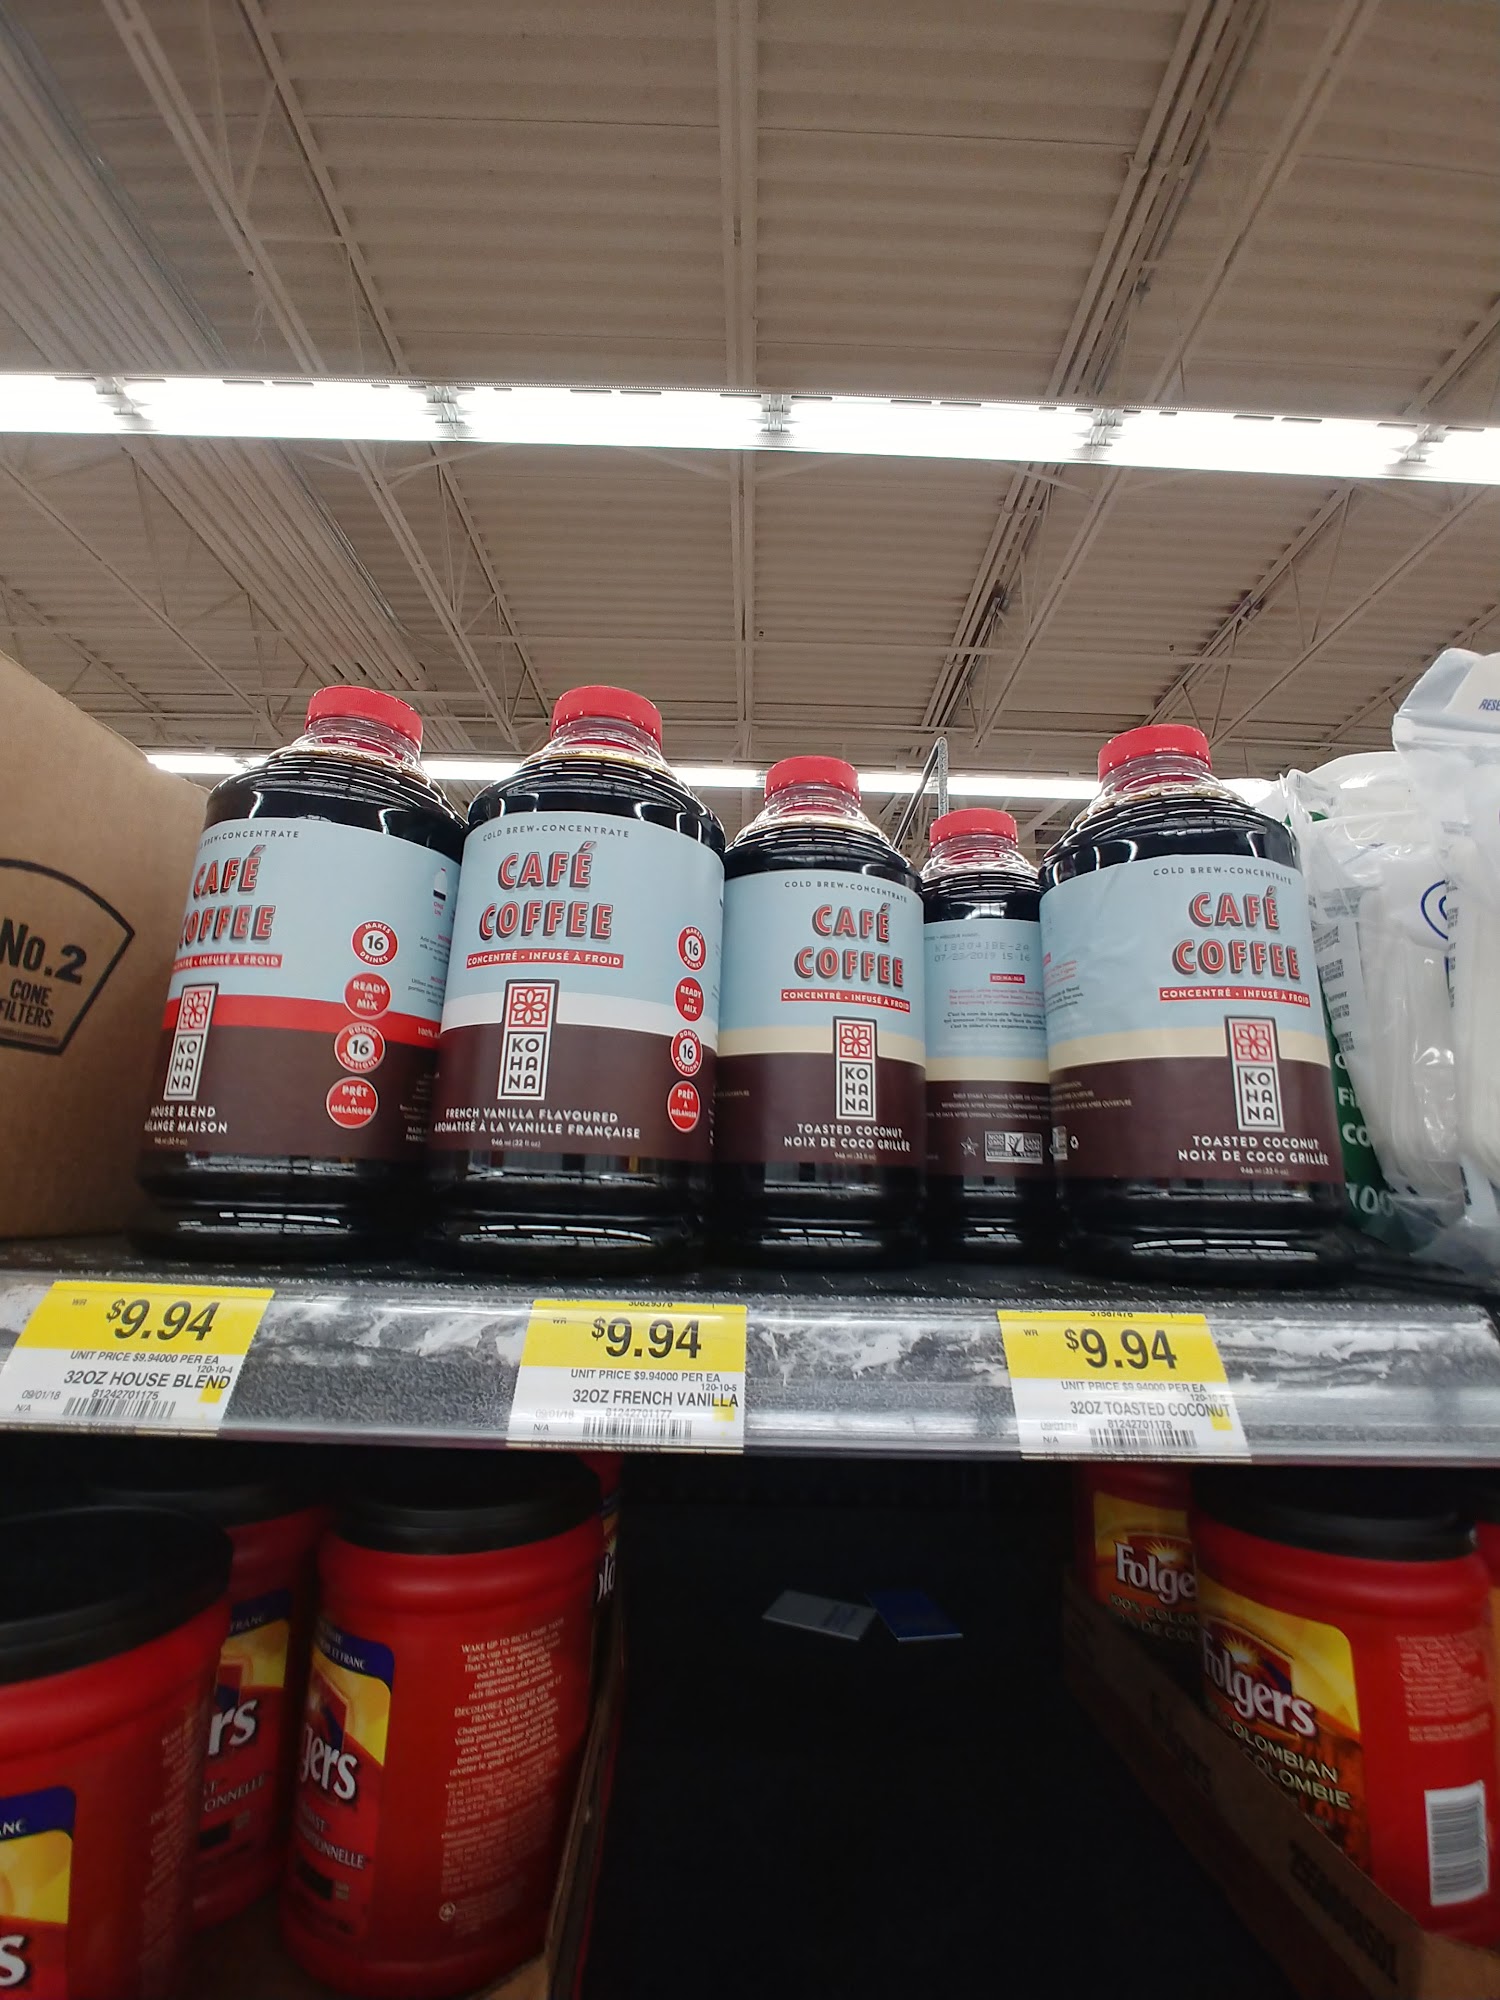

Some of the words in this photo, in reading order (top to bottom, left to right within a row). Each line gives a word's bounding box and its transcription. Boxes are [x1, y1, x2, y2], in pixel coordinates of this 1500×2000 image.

[222, 830, 299, 840] CONCENTRATE
[483, 829, 502, 841] COLD
[506, 825, 534, 834] BREW
[542, 824, 629, 838] CONCENTRATE
[193, 845, 266, 898] CAFÉ
[498, 841, 597, 890] CAFÉ
[1153, 867, 1184, 876] COLD
[1190, 866, 1222, 874] BREW
[1230, 867, 1292, 885] CONCENTRATE
[850, 884, 907, 903] CONCENTRATE
[1188, 885, 1280, 930] CAFÉ
[179, 905, 276, 949] COFFEE
[479, 899, 613, 941] COFFEE
[812, 902, 891, 943] CAFÉ
[365, 922, 391, 934] MAKES
[367, 935, 384, 951] 16
[688, 940, 699, 956] 16
[233, 953, 240, 965] À
[243, 955, 279, 966] FROID
[359, 951, 388, 963] DRINKS
[467, 950, 517, 966] CONCENTRÉ
[529, 950, 569, 961] INFUSÉ
[573, 951, 581, 962] À
[585, 954, 621, 965] FROID
[1172, 938, 1300, 980] COFFEE
[794, 946, 903, 988] COFFEE
[10, 978, 52, 1007] CONE
[353, 980, 387, 996] READY
[364, 991, 374, 1000] TO
[680, 985, 701, 999] READY
[783, 991, 841, 1000] CONCENTRÉ
[851, 994, 881, 1005] INFUSÉ
[890, 1000, 910, 1010] FROID
[1162, 988, 1231, 998] CONCENTRÉ
[1243, 989, 1278, 999] INFUSÉ
[1289, 993, 1310, 1005] FROID
[356, 999, 378, 1011] MIX
[684, 1003, 697, 1015] MIX
[177, 1040, 197, 1055] KO
[352, 1039, 369, 1056] 16
[512, 1038, 539, 1053] KO
[683, 1044, 693, 1059] 16
[174, 1058, 194, 1073] HA
[510, 1056, 538, 1071] HA
[675, 1056, 699, 1072] PORTIONS
[845, 1067, 868, 1080] KO
[1244, 1071, 1271, 1086] KO
[171, 1075, 191, 1090] NA
[508, 1074, 536, 1089] NA
[845, 1082, 869, 1096] HA
[1246, 1089, 1273, 1103] HA
[151, 1105, 175, 1118] HOUSE
[177, 1105, 216, 1118] BLEND
[845, 1098, 869, 1111] NA
[446, 1108, 479, 1119] FRENCH
[483, 1107, 534, 1120] VANILLA
[539, 1108, 618, 1123] FLAVOURED
[1248, 1106, 1275, 1121] NA
[177, 1121, 228, 1134] MAISON
[434, 1119, 476, 1133] AROMATISÉ
[479, 1119, 486, 1131] À
[490, 1121, 504, 1133] LA
[509, 1121, 563, 1135] VANILLE
[568, 1124, 641, 1139] FRANÇAISE
[797, 1123, 851, 1135] TOASTED
[856, 1125, 902, 1139] COCONUT
[784, 1136, 816, 1147] NOIX
[820, 1136, 836, 1148] DE
[840, 1138, 874, 1149] COCO
[877, 1138, 911, 1152] GRILLÉE
[1192, 1135, 1258, 1147] TOASTED
[1263, 1136, 1319, 1150] COCONUT
[1177, 1149, 1217, 1162] NOIX
[1222, 1150, 1240, 1162] DE
[1246, 1150, 1285, 1163] COCO
[1289, 1151, 1330, 1166] GRILLÉE
[106, 1298, 220, 1341] $9.94
[591, 1316, 702, 1359] $9.94
[1064, 1328, 1177, 1370] $9.94
[70, 1350, 97, 1360] UNIT
[97, 1352, 130, 1362] PRICE
[133, 1353, 178, 1363] $9.94000
[180, 1354, 202, 1364] PER
[204, 1355, 219, 1364] EA
[197, 1365, 233, 1374] 120-10-4
[571, 1369, 597, 1378] UNIT
[599, 1370, 631, 1380] PRICE
[633, 1371, 679, 1382] $9.94000
[681, 1372, 703, 1382] PER
[706, 1373, 721, 1382] EA
[64, 1370, 108, 1385] 32OZ
[109, 1372, 171, 1388] HOUSE
[173, 1373, 231, 1389] BLEND
[701, 1383, 738, 1391] 120-10-5
[1061, 1381, 1086, 1391] UNIT
[1088, 1382, 1119, 1391] PRICE
[1122, 1382, 1166, 1392] $9.94000
[1168, 1383, 1190, 1393] PER
[1192, 1384, 1207, 1393] EA
[22, 1390, 61, 1400] 09/01/18
[92, 1389, 159, 1400] 81242701175
[572, 1389, 609, 1404] 32OZ
[613, 1390, 673, 1406] FRENCH
[677, 1392, 739, 1408] VANILLA
[14, 1404, 31, 1413] N/A
[605, 1407, 672, 1419] 81242701177
[1070, 1401, 1104, 1415] 32OZ
[1105, 1401, 1165, 1417] TOASTED
[1169, 1402, 1230, 1418] COCONUT
[533, 1423, 550, 1432] N/A
[1108, 1419, 1172, 1429] 81242701178
[1042, 1435, 1059, 1444] N/A
[1202, 1629, 1318, 1738] Folgers
